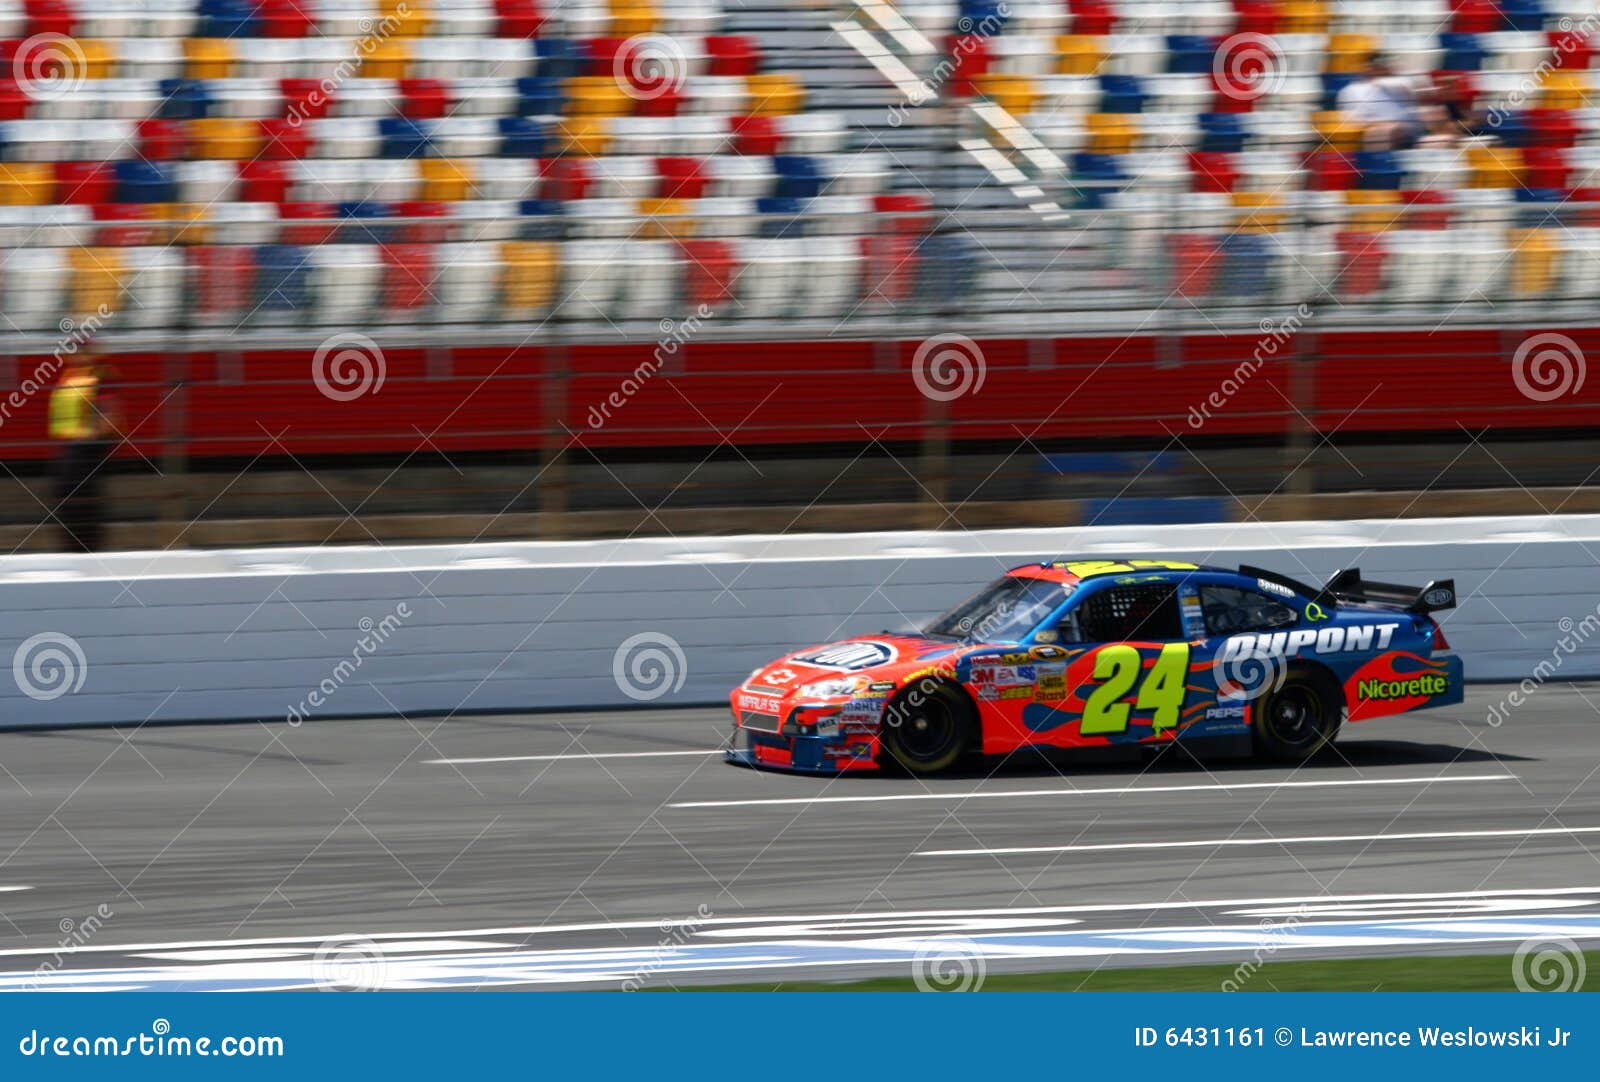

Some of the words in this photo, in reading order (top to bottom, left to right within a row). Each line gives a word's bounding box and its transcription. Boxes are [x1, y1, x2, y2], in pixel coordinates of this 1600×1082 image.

[1221, 623, 1400, 664] DUPONT
[971, 668, 996, 683] 3M
[1080, 642, 1190, 735] 24
[1358, 676, 1446, 699] Nicorette
